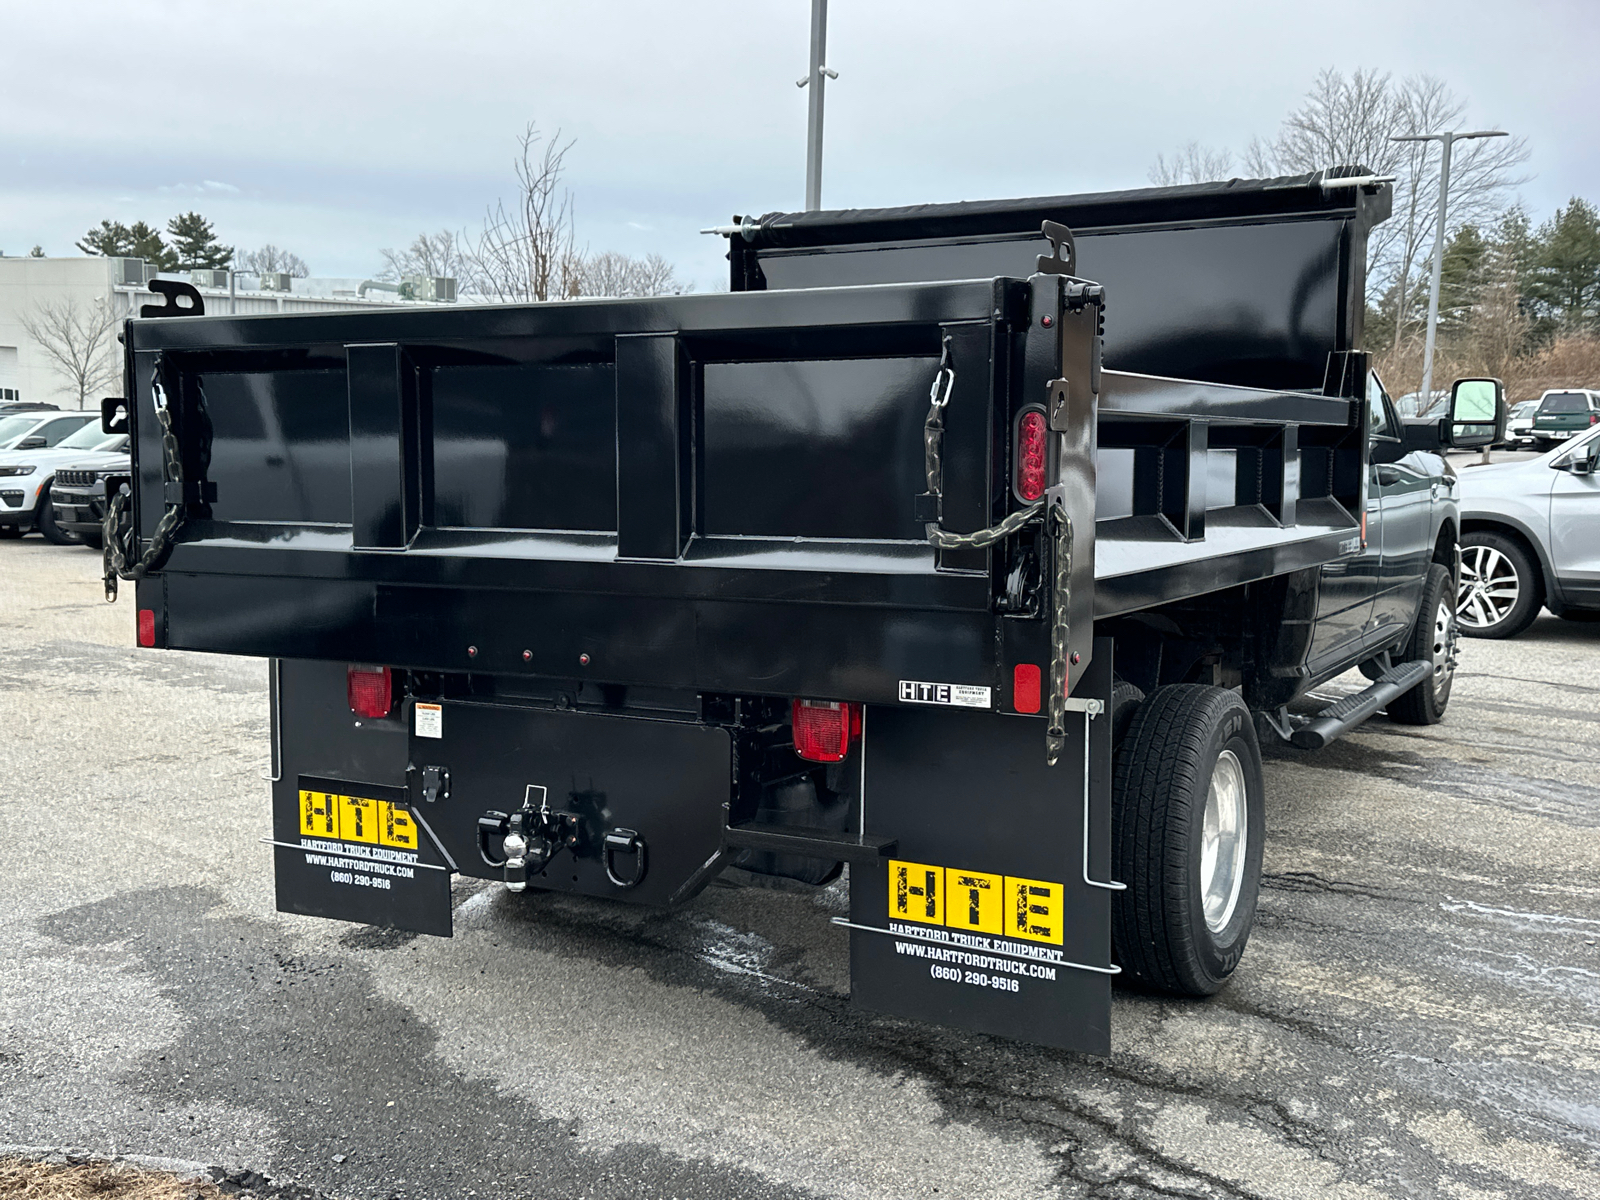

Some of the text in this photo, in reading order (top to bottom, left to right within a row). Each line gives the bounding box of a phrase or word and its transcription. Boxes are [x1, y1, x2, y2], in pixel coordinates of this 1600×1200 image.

[901, 682, 950, 702] HTE
[304, 792, 410, 843] HTE
[300, 838, 418, 864] HARTFORD TRUCK EQUIPMENT
[305, 853, 414, 878] WWW.HARTFORDTRUCK.COM
[330, 870, 391, 890] (860) 290-9516
[896, 866, 1051, 937] HTE
[889, 923, 1064, 962] HARTFORD TRUCK EQUIPMENT
[895, 941, 1056, 980] WWW.HARTFORDTRUCK.COM
[930, 964, 1020, 993] (860) 290-9516
